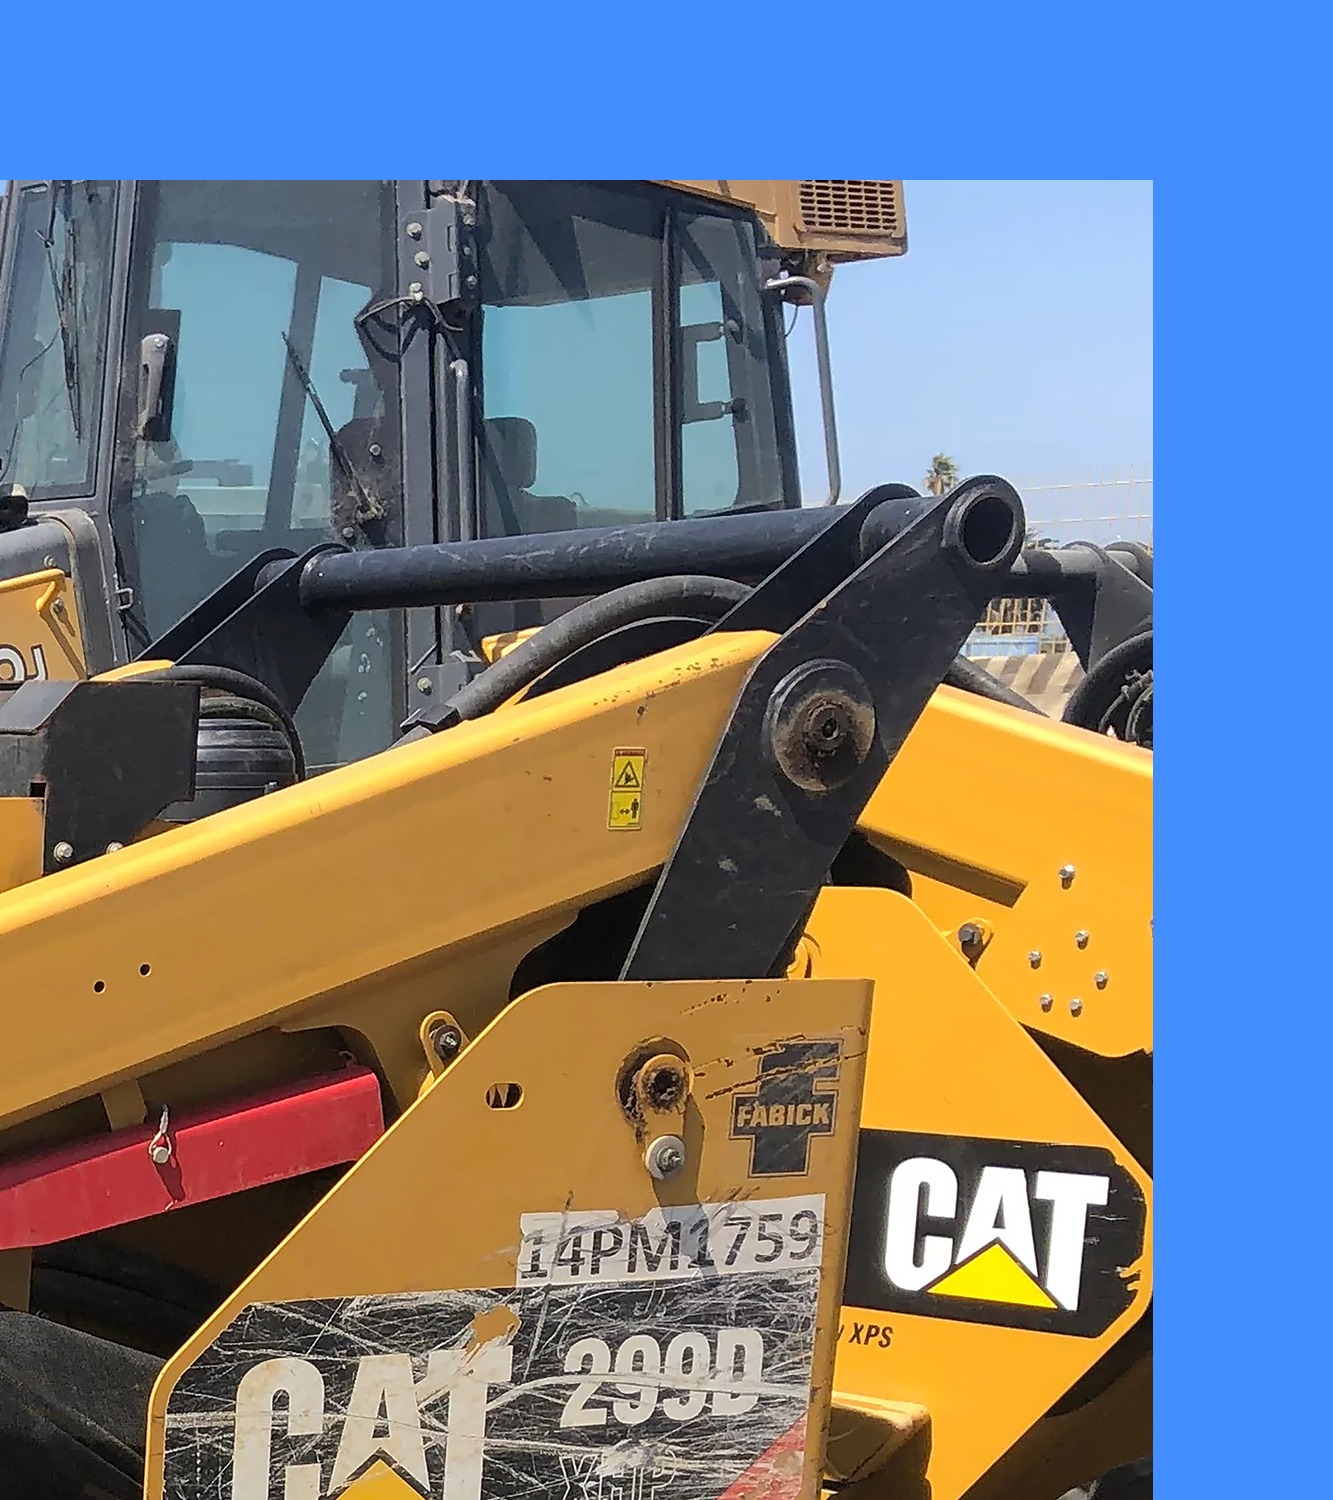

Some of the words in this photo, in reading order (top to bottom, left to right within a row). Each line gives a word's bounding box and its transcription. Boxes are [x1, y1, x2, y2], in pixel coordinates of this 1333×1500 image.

[736, 1102, 830, 1128] FABICK
[520, 1209, 819, 1280] 14PM1759
[884, 1157, 1110, 1312] CAT
[848, 1322, 894, 1348] XPS
[559, 1327, 765, 1429] 299D
